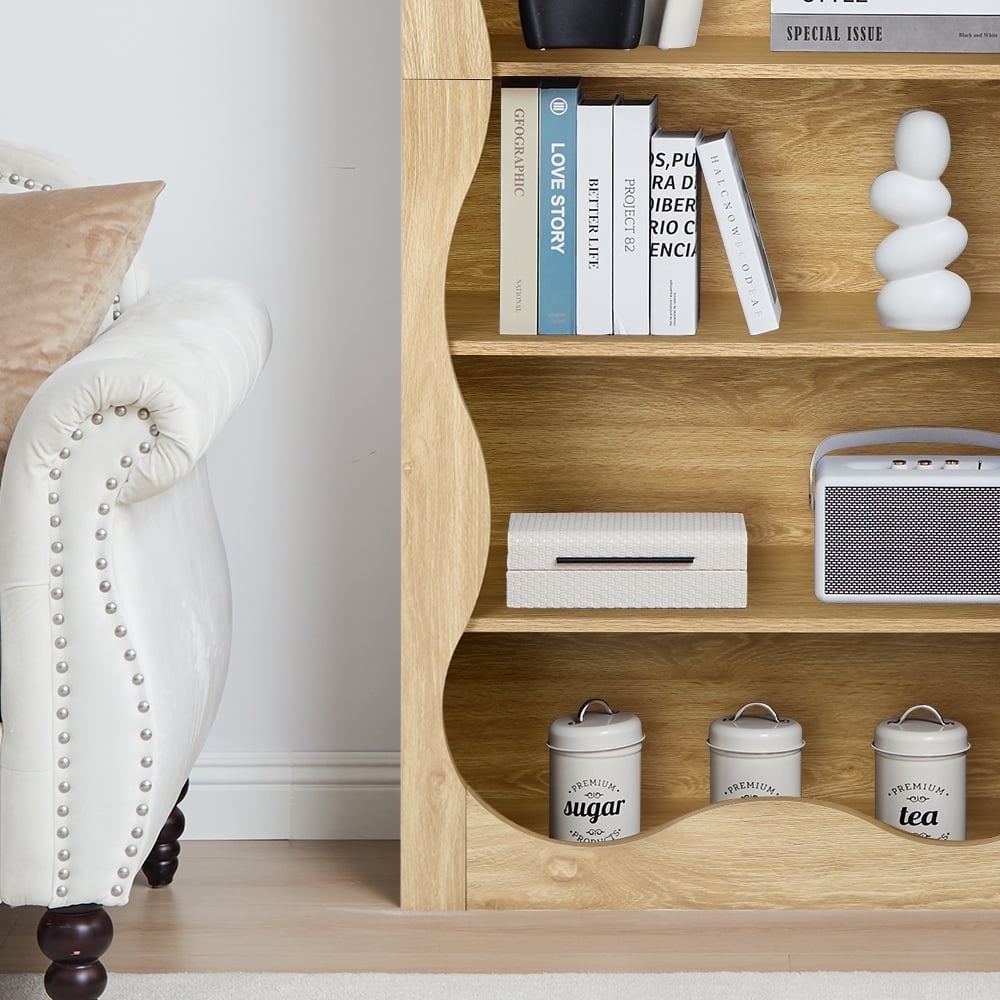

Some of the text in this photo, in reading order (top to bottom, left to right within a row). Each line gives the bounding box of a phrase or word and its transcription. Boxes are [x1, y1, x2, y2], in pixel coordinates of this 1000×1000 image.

[786, 25, 883, 42] SPECIAL ISSUE
[651, 175, 676, 190] RA
[550, 142, 566, 255] LOVE STORY
[588, 178, 599, 270] BETTER LIFE
[623, 178, 636, 253] PROJECT 82
[571, 779, 616, 793] PREMIUM
[727, 781, 776, 795] PREMIUM
[891, 782, 945, 796] PREMIUM
[563, 799, 626, 824] sugar
[899, 806, 939, 826] tea
